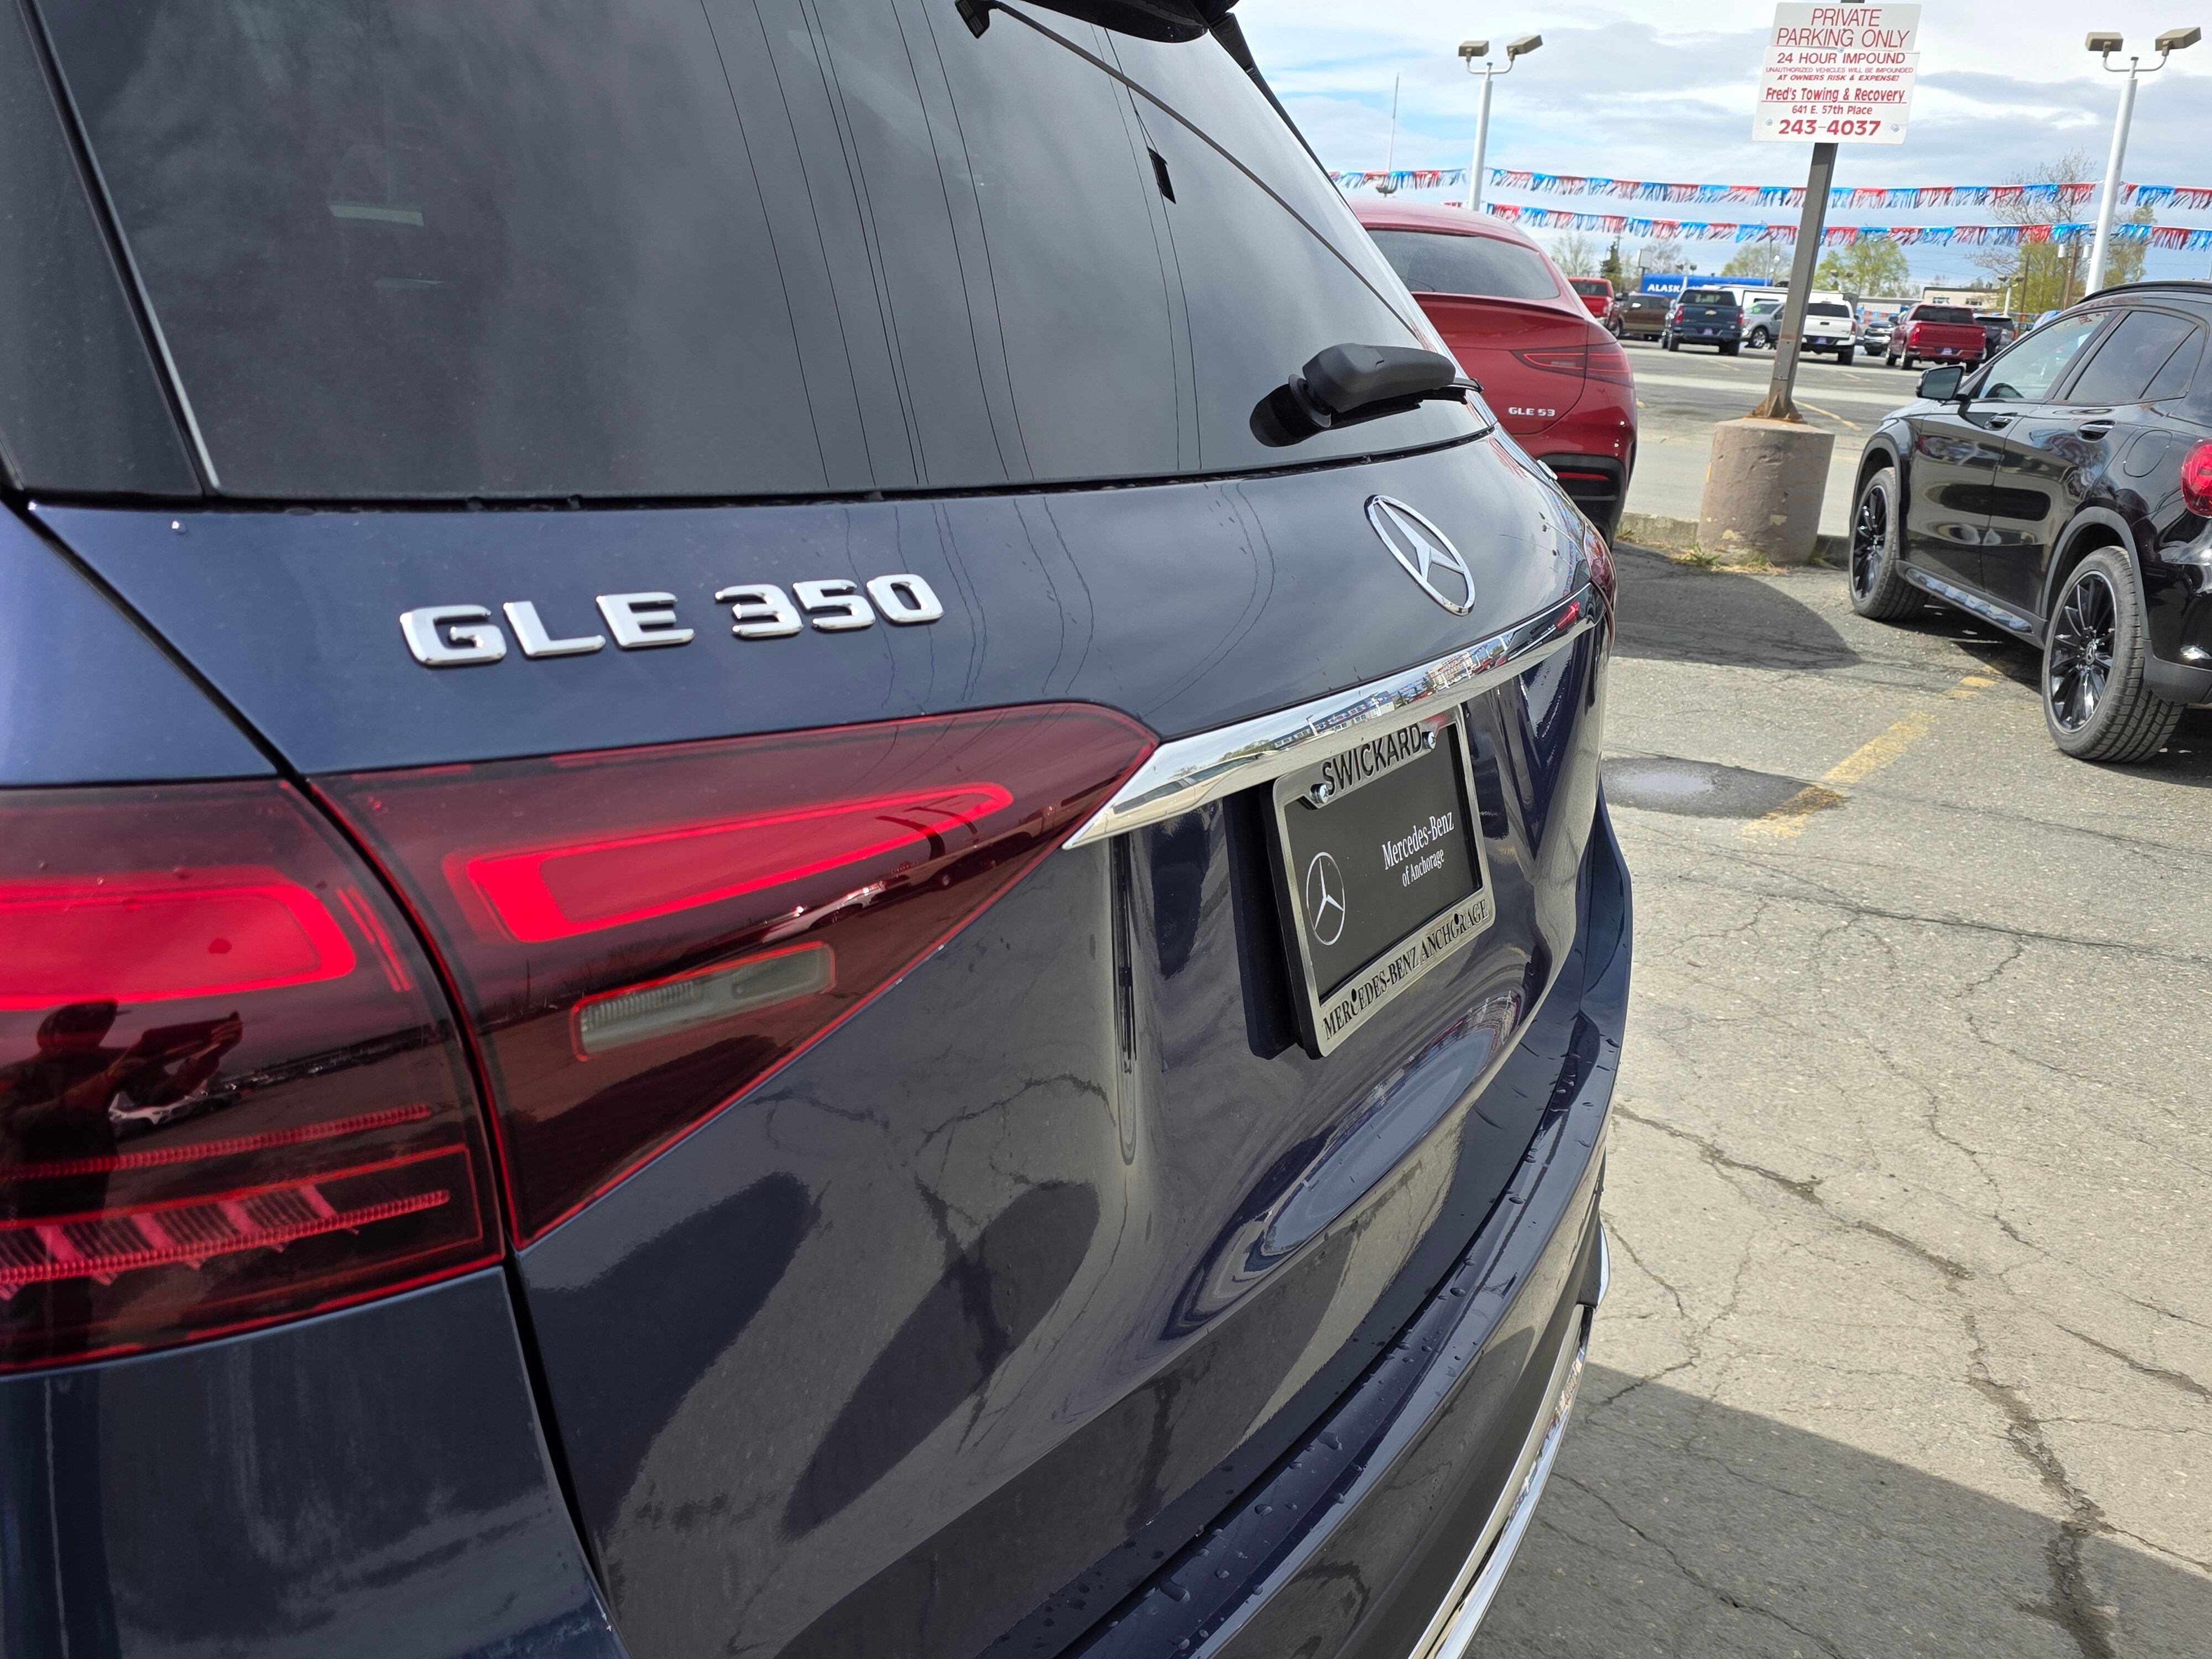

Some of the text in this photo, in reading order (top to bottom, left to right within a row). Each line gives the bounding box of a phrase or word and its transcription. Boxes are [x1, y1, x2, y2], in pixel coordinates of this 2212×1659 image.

[1811, 8, 1882, 27] PRIVATE
[1776, 28, 1910, 48] PARKING ONLY
[1777, 53, 1906, 64] 24 HOUR IMPOUND
[1766, 87, 1905, 103] Fred's Towing & Recovery
[1792, 105, 1872, 114] 641 E. 57th Place
[1778, 119, 1881, 135] 243-4037
[1509, 407, 1555, 416] GLE 53
[400, 573, 945, 666] GLE 350
[1322, 723, 1422, 795] SWICKARD
[1382, 812, 1454, 870] Mercedes-Benz
[1402, 849, 1444, 886] of Anchorage
[1322, 899, 1489, 1040] MERCEDES-BENZ ANCHORAGE
